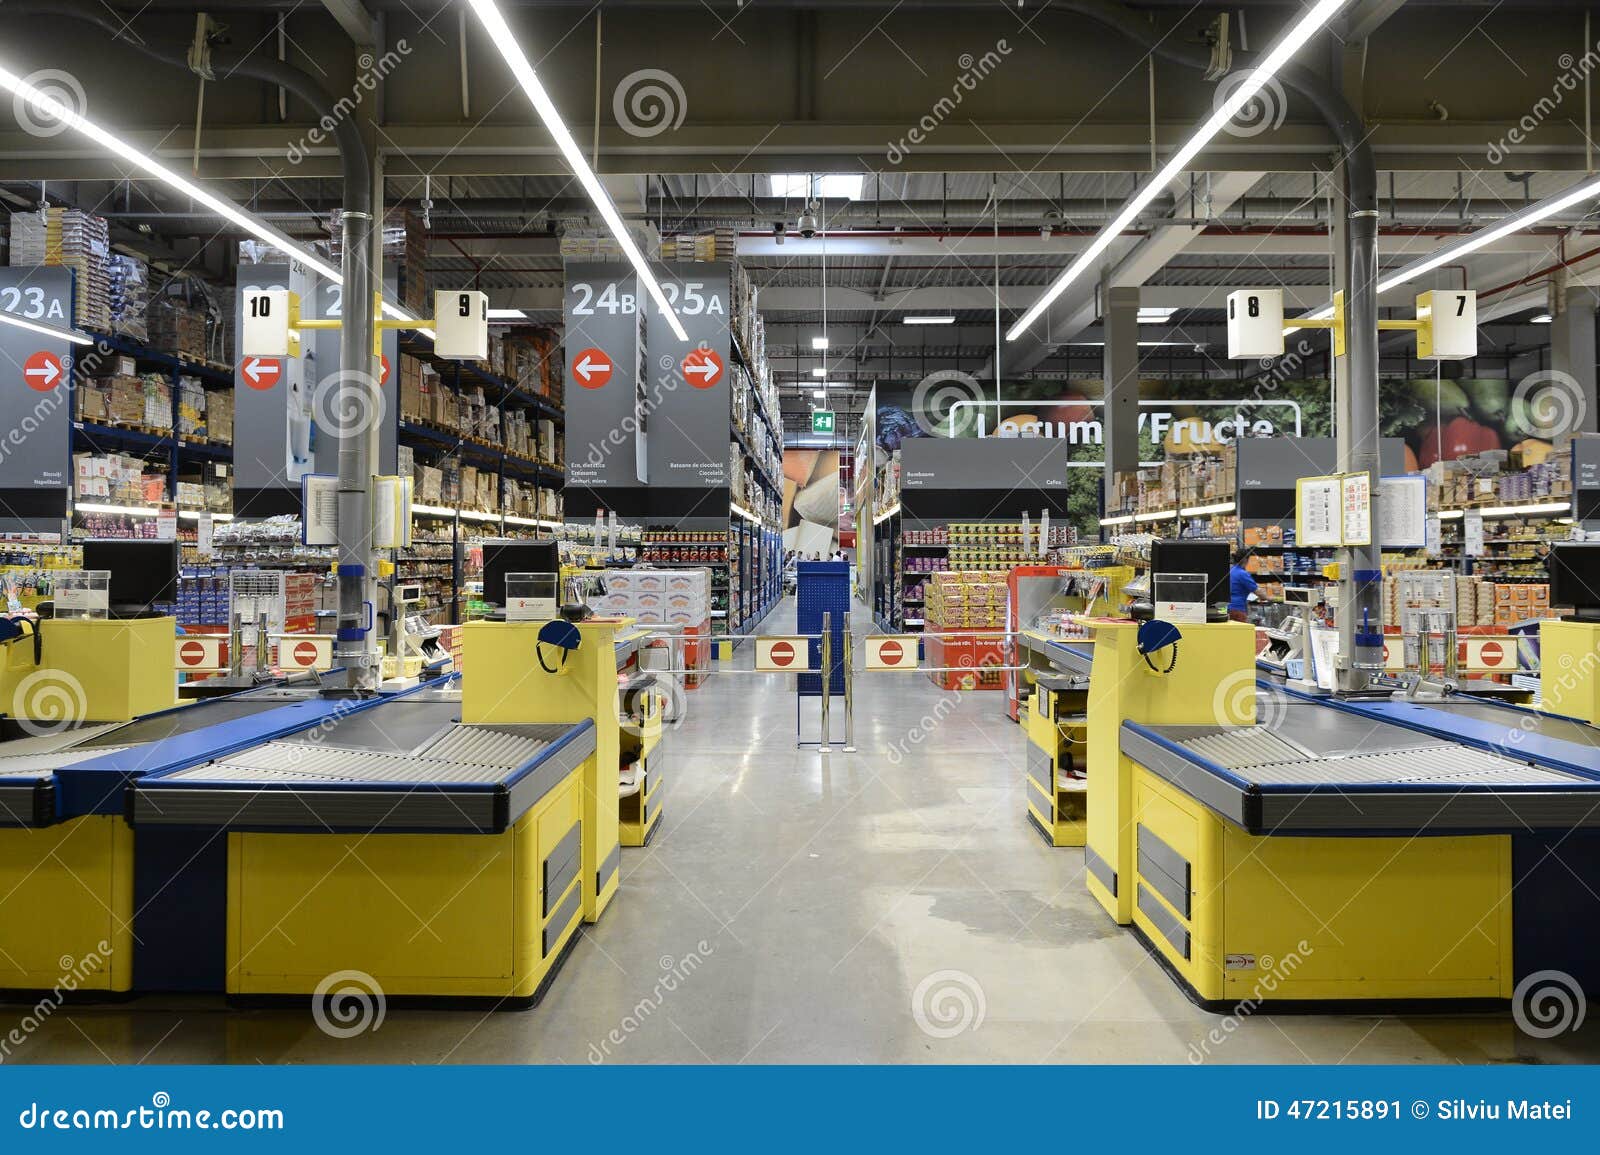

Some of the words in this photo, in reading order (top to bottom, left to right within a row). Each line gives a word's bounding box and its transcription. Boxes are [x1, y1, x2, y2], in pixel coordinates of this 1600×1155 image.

[1, 287, 64, 318] 23A
[250, 296, 270, 317] 10
[459, 294, 470, 317] 9
[571, 283, 636, 315] 24B
[658, 283, 724, 315] 25A
[1248, 296, 1259, 317] 8
[1456, 296, 1466, 317] 7
